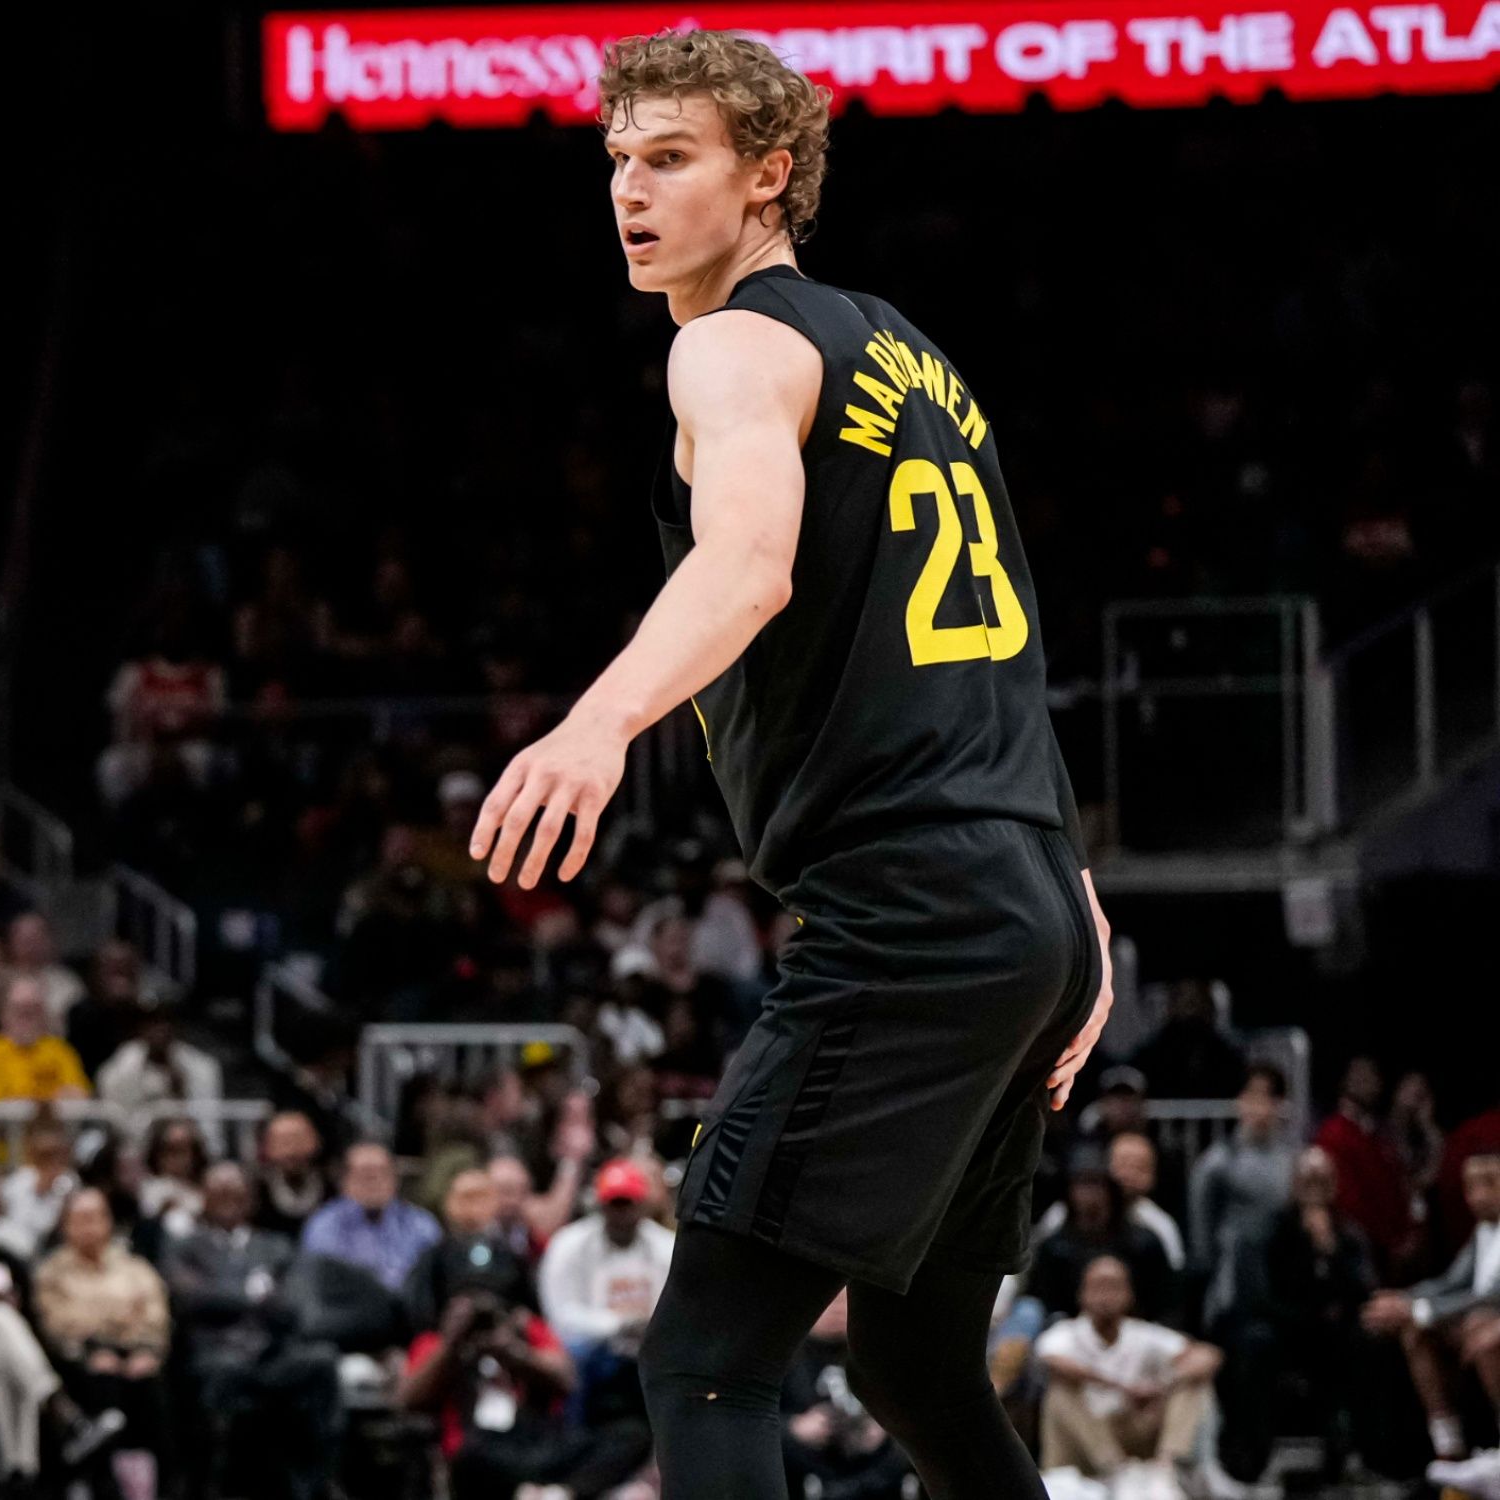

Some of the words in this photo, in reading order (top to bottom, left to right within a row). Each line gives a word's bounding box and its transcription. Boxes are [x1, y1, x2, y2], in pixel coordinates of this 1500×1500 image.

[287, 25, 601, 111] Hennessy
[740, 24, 987, 85] PIRIT
[994, 19, 1117, 82] OF
[1126, 12, 1294, 77] THE
[889, 459, 1029, 666] 23
